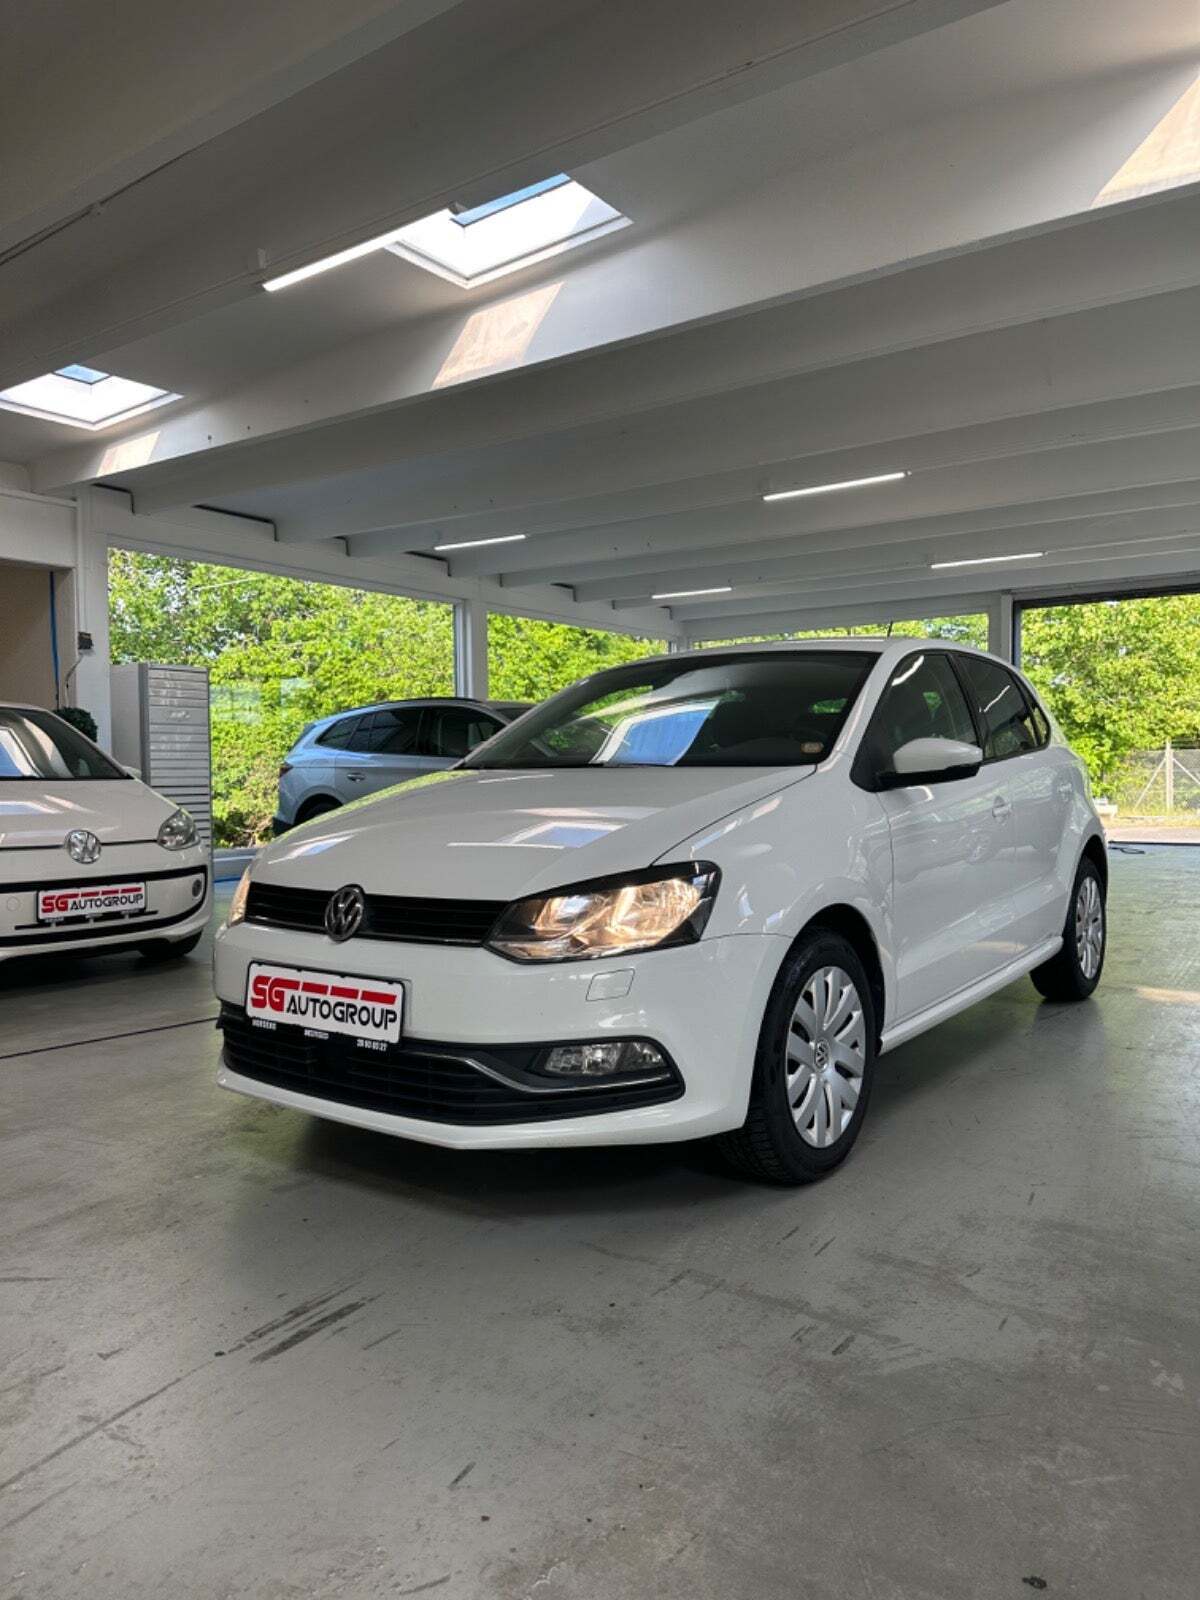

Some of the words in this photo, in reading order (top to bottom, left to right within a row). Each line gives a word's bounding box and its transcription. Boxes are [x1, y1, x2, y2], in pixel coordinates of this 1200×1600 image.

[41, 893, 79, 913] SG
[70, 893, 144, 911] AUTOGROUP
[250, 975, 300, 1012] SG
[286, 994, 398, 1030] AUTOGROUP
